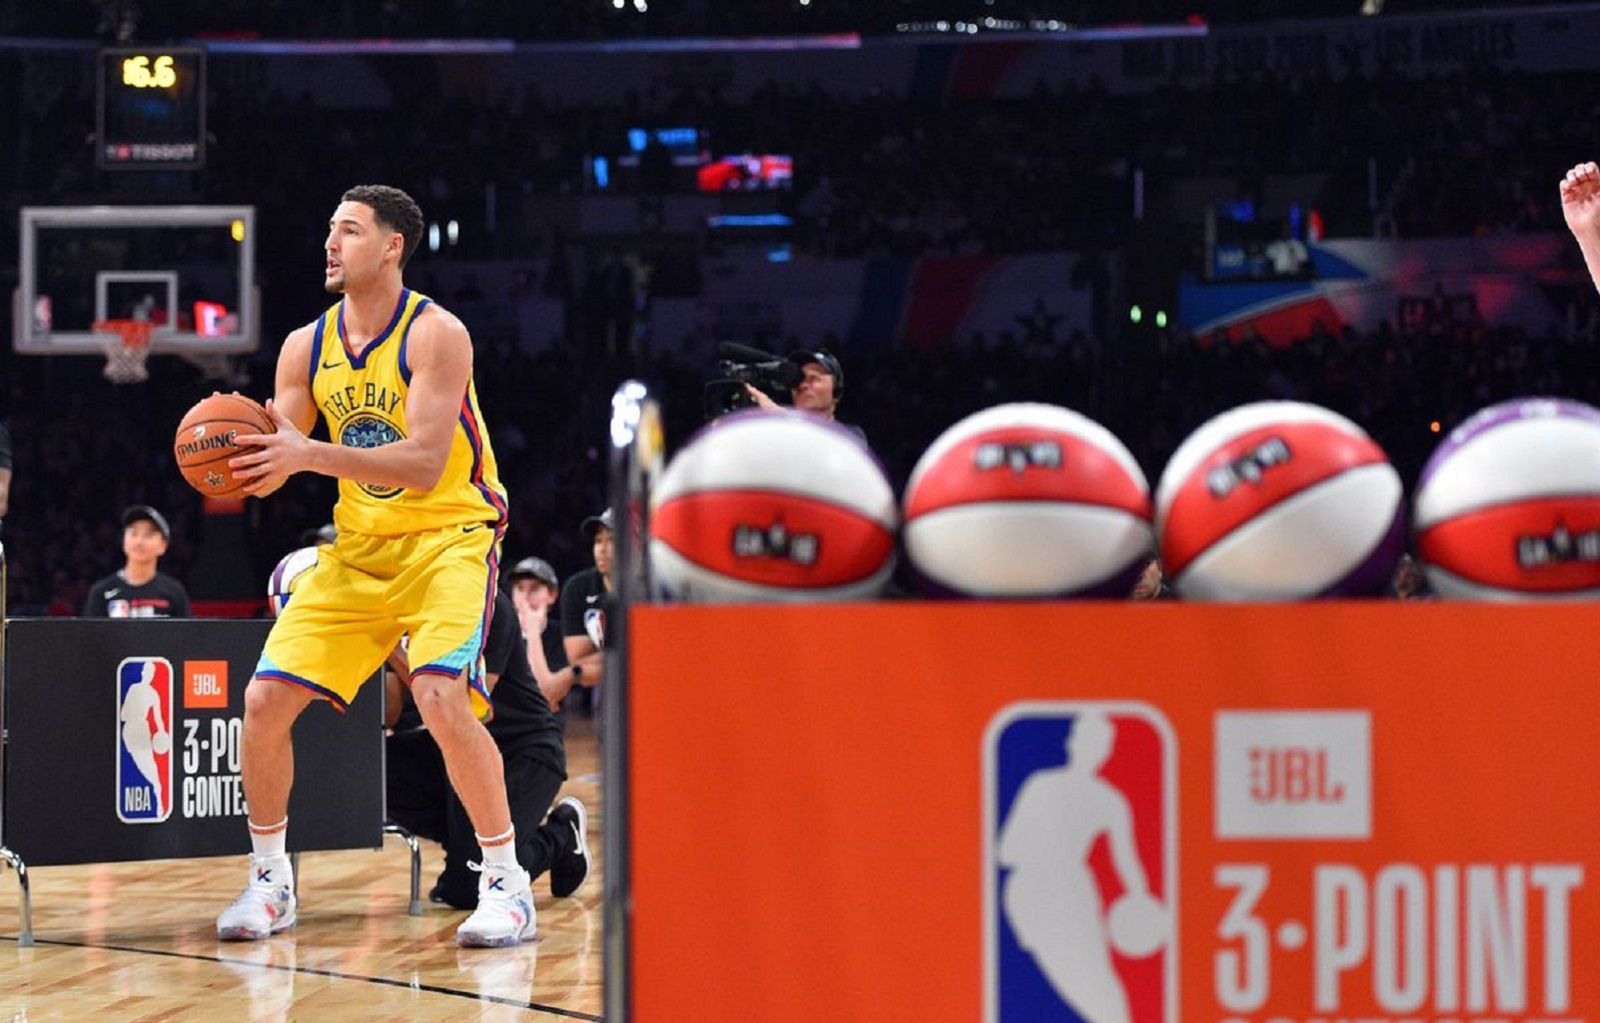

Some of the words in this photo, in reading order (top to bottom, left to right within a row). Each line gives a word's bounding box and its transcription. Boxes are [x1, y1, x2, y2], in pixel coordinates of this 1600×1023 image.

[132, 144, 197, 160] TISSOT
[323, 385, 361, 421] THE
[364, 382, 401, 415] BAY
[192, 673, 221, 696] JBL
[1248, 745, 1346, 805] JBL
[124, 785, 152, 812] NBA
[182, 775, 249, 818] CONTE
